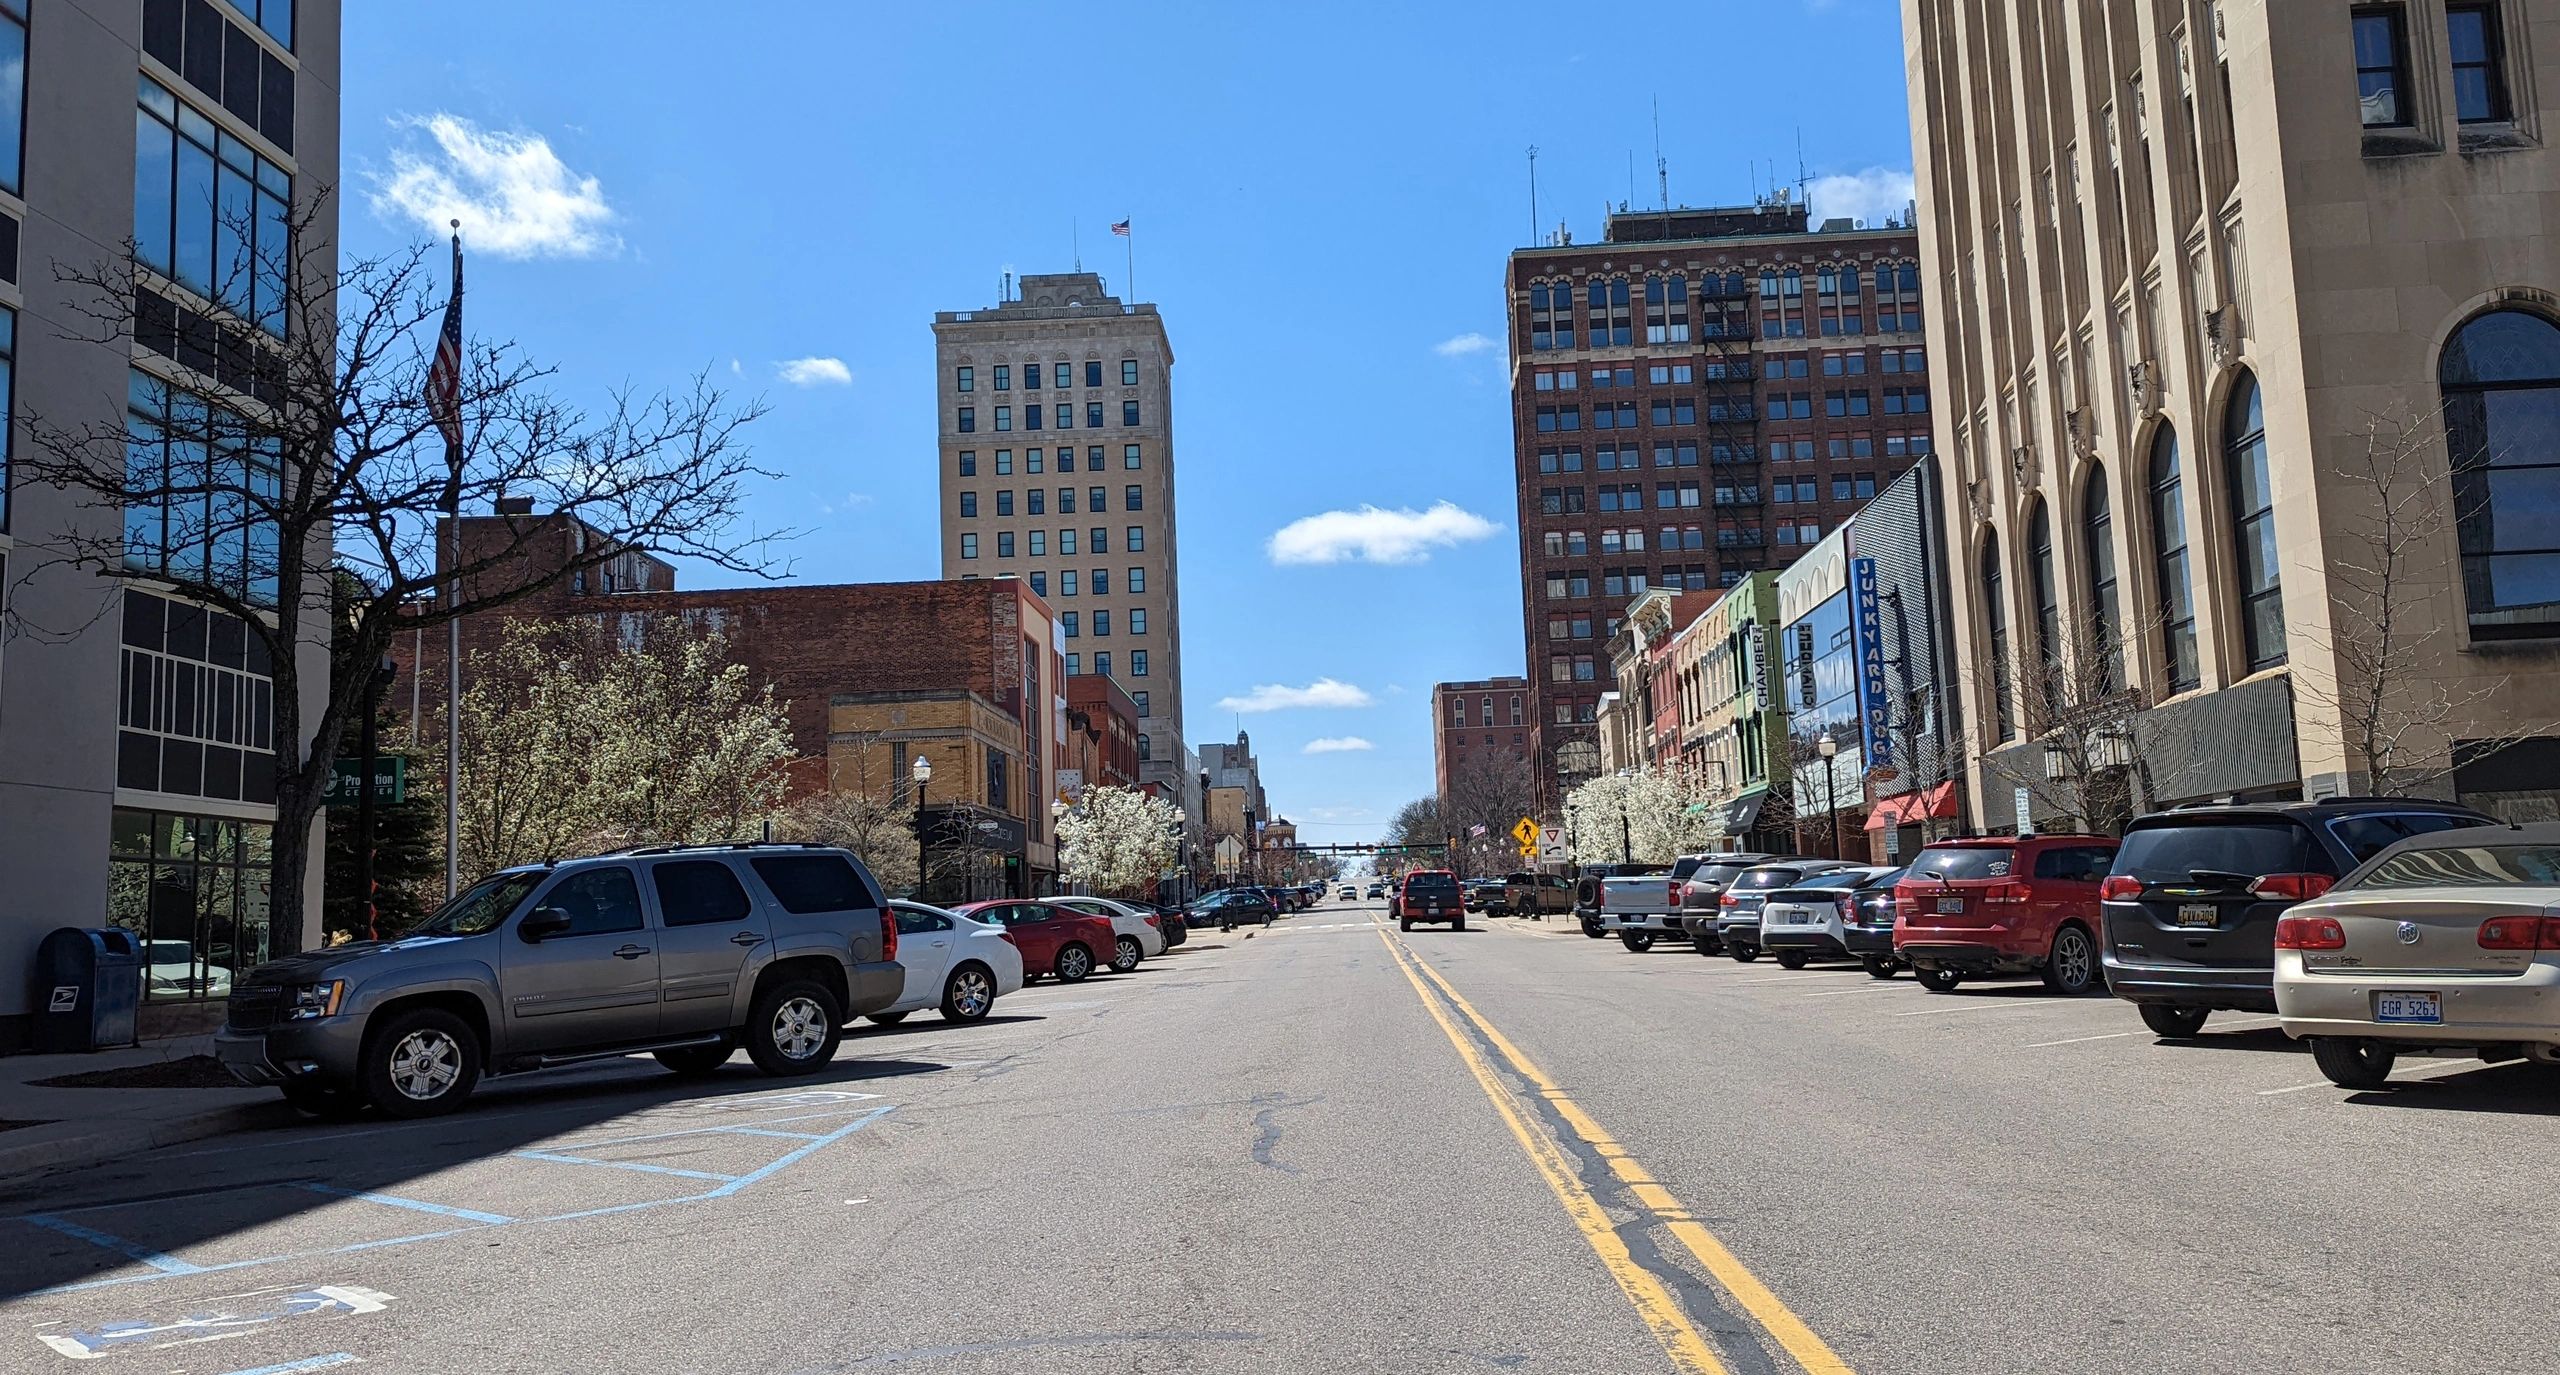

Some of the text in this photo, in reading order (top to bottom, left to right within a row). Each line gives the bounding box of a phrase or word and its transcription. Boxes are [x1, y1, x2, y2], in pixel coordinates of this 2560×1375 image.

[1860, 560, 1883, 694] JUNKYARD
[1753, 634, 1768, 708] CHAMBER
[1871, 708, 1888, 755] DOG
[345, 774, 393, 786] Protion
[345, 788, 393, 796] CEER
[2381, 1000, 2436, 1016] EGR 5263
